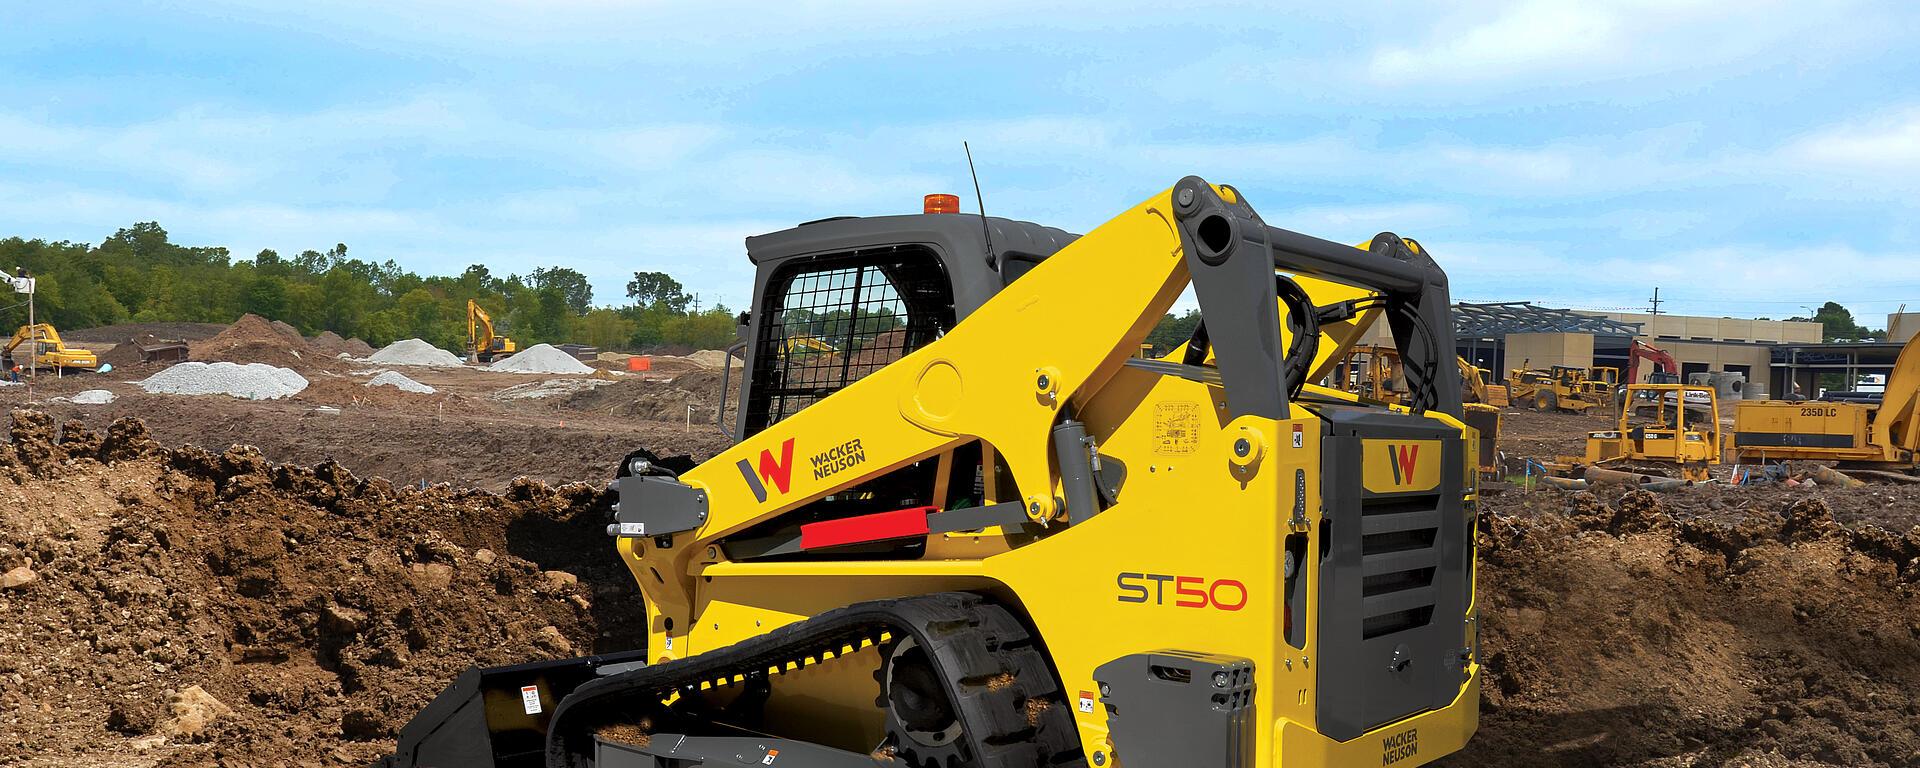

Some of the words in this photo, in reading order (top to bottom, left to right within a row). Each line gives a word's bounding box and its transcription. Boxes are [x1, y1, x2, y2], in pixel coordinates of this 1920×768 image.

[1801, 408, 1823, 417] 235D
[1825, 408, 1837, 417] LC
[809, 438, 863, 468] WACKER
[813, 450, 866, 481] NEUSON
[1388, 444, 1419, 486] W
[736, 437, 795, 503] W
[1117, 572, 1247, 611] ST50
[1383, 728, 1418, 751] WACKER
[1383, 742, 1418, 767] NEUSON
